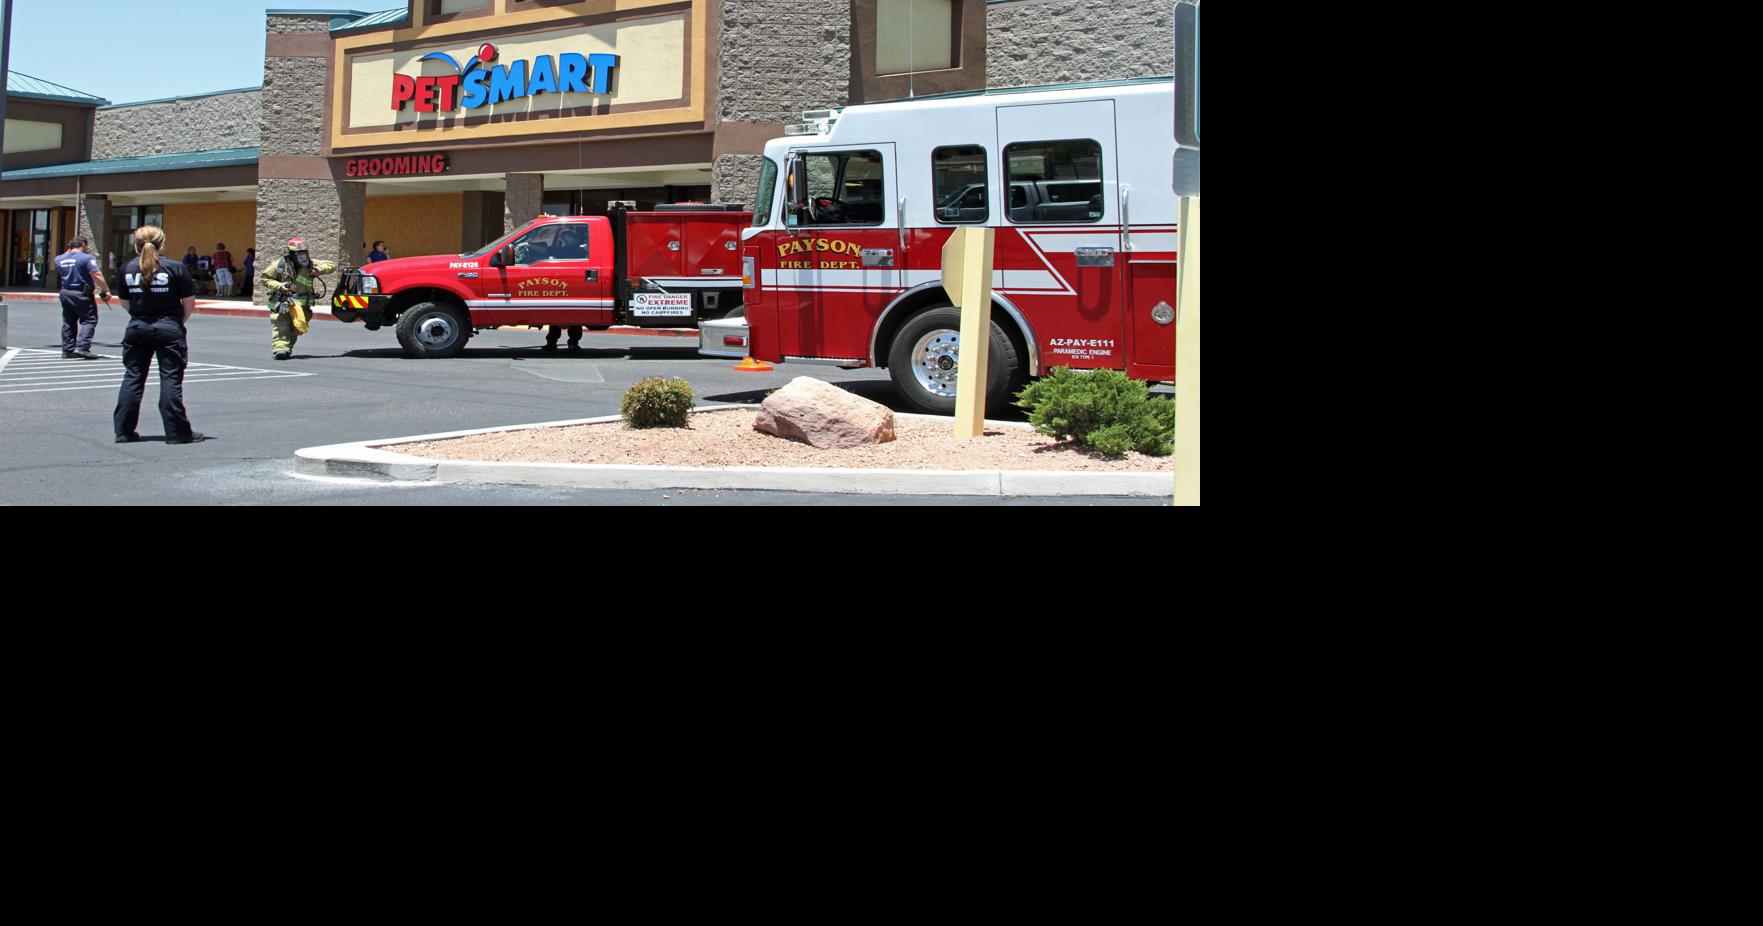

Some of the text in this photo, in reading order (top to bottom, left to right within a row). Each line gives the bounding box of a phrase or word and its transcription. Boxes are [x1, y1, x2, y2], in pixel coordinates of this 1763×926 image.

[345, 154, 445, 176] GROOMING
[777, 238, 861, 257] PAYSON
[780, 261, 860, 269] FIRE DEPT.
[518, 277, 568, 289] PAYSON
[1049, 338, 1115, 347] AZ-PAY-E111
